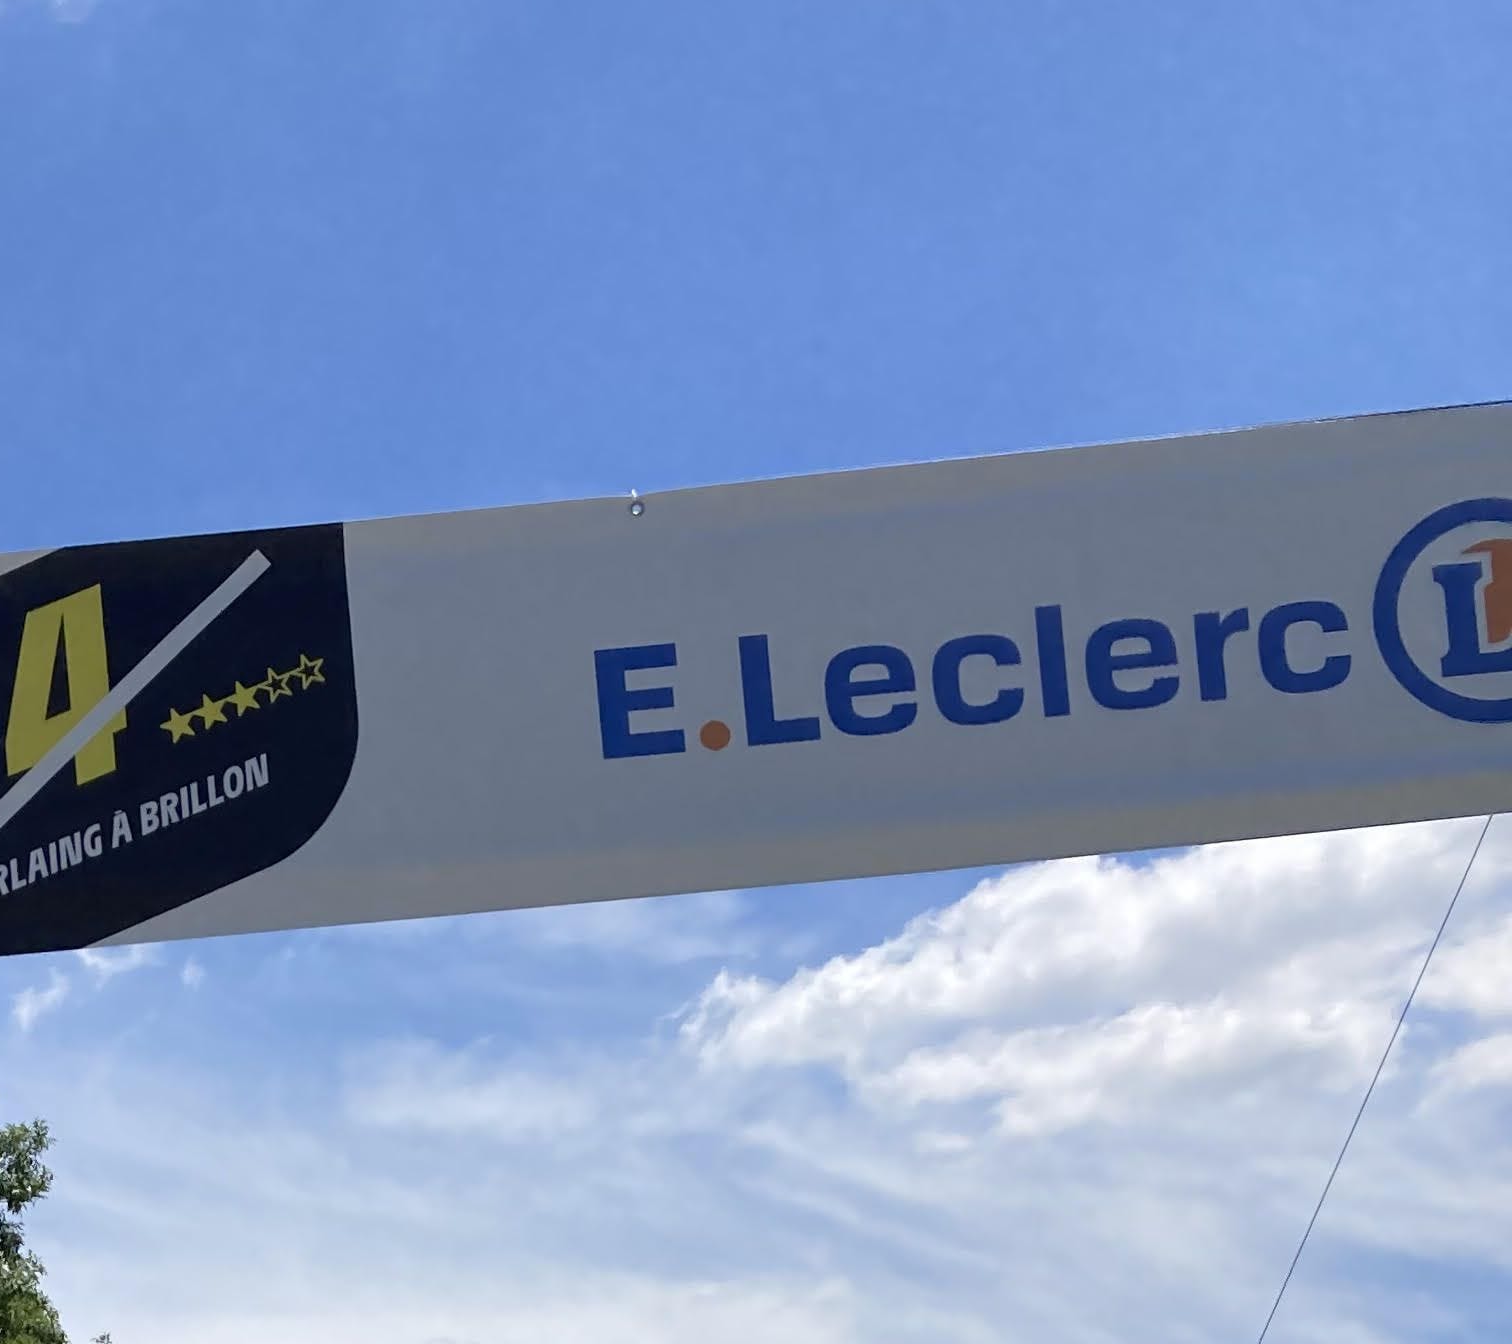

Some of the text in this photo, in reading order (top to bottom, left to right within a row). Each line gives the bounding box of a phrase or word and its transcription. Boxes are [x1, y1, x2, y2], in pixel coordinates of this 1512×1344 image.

[5, 583, 128, 786] 4
[593, 601, 1351, 759] E.Leclerc
[111, 810, 134, 849] À
[139, 752, 270, 837] BRILLON
